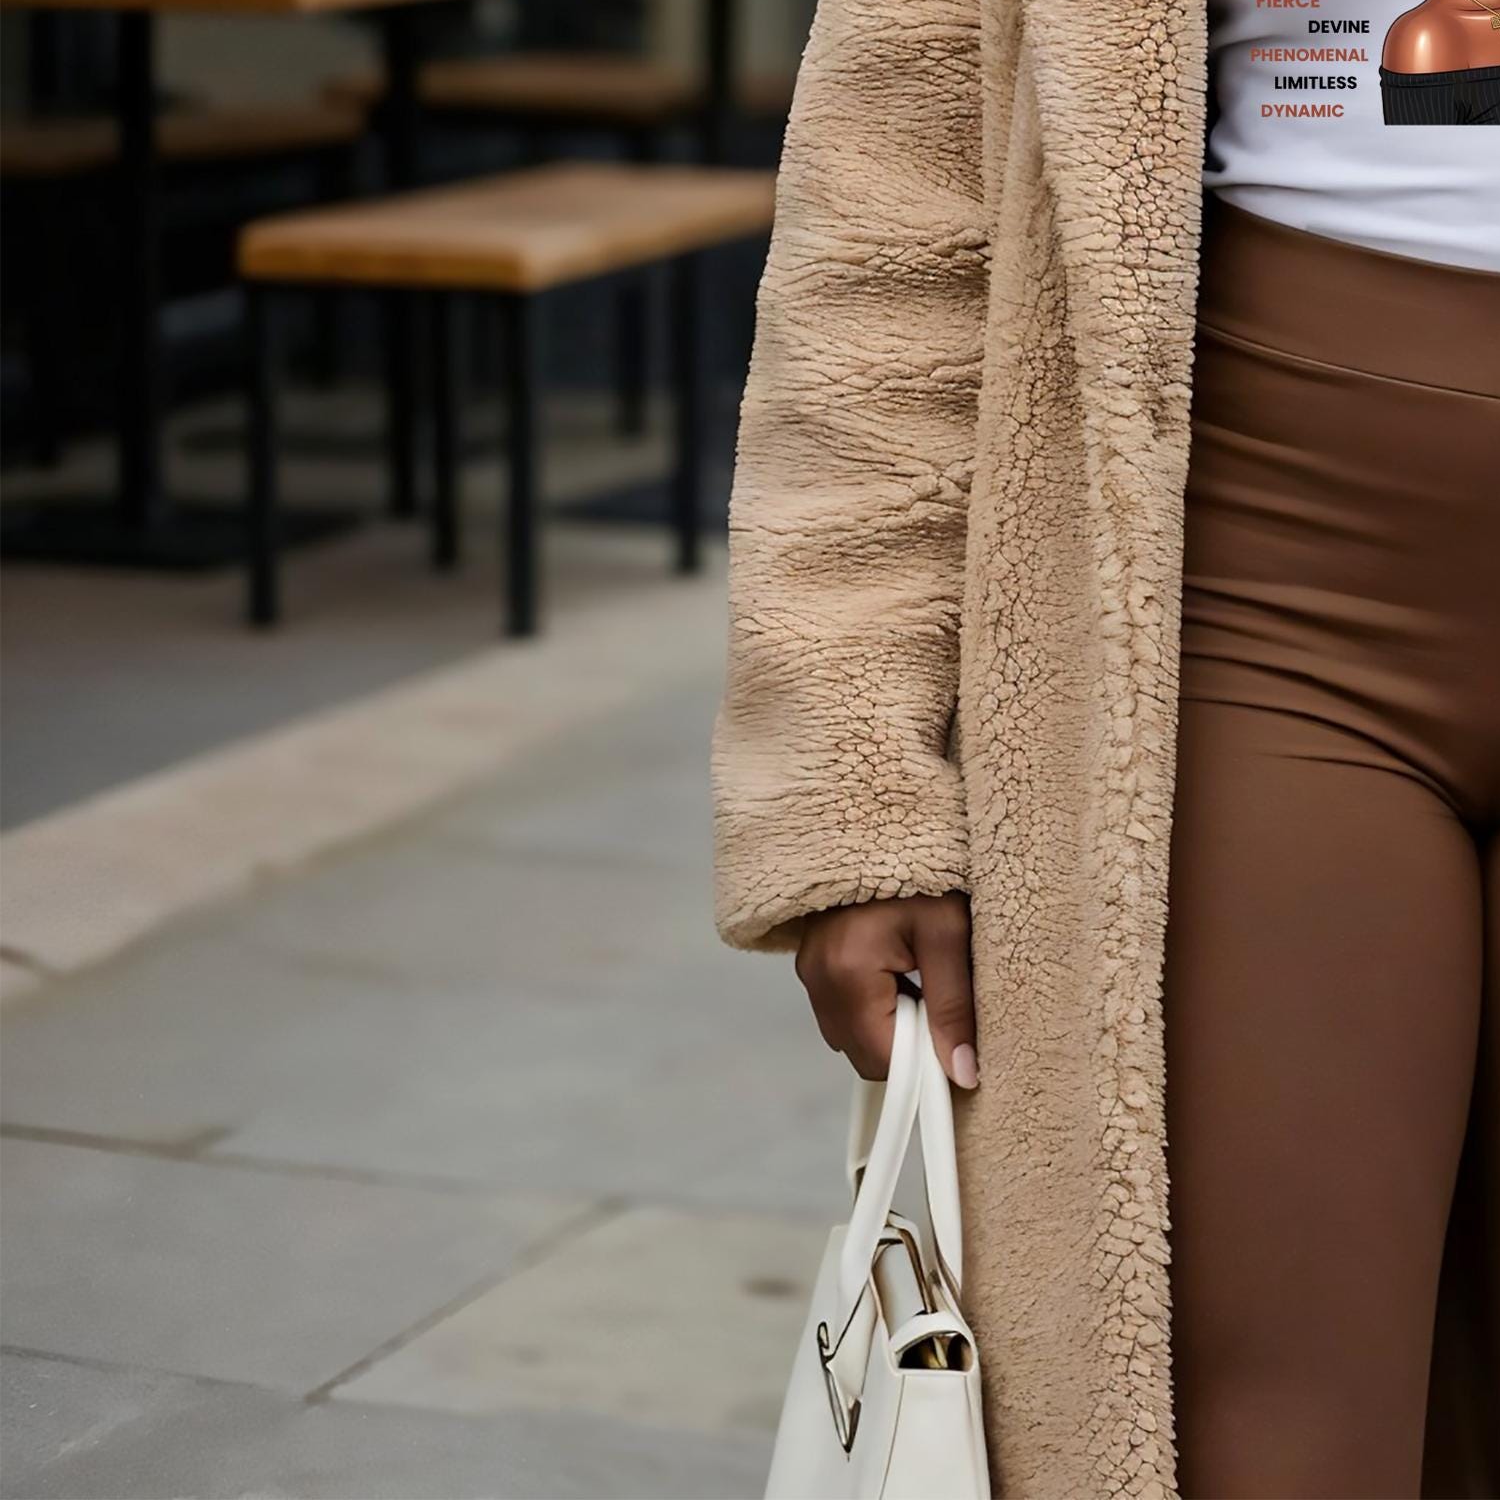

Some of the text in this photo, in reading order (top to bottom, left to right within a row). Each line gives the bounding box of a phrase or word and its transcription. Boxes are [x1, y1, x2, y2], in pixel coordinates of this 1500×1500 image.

[1308, 19, 1370, 34] DEVINE
[1249, 47, 1369, 63] PHENOMENAL
[1274, 75, 1358, 90] LIMITLESS
[1260, 104, 1345, 118] DYNAMIC
